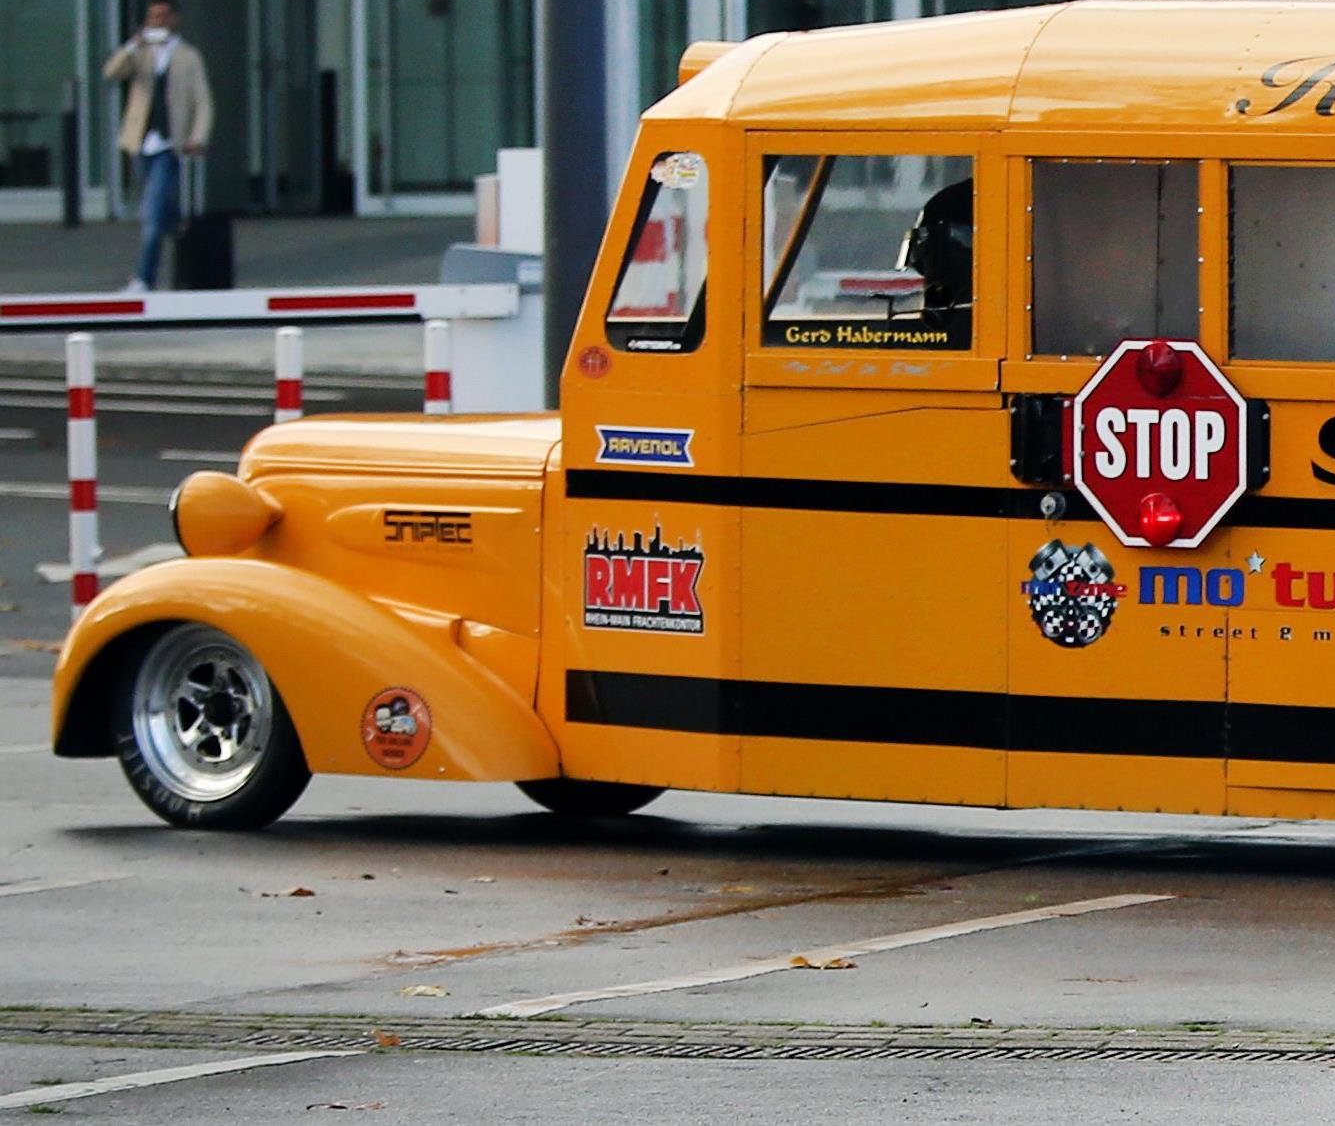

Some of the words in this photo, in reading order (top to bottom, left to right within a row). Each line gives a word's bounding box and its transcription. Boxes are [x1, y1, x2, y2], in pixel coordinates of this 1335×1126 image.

[786, 327, 831, 343] Gerd
[837, 326, 948, 343] Habermann
[608, 438, 683, 455] RAVENOL
[1095, 407, 1226, 480] STOP
[586, 555, 701, 614] RMFK
[1160, 626, 1258, 640] street
